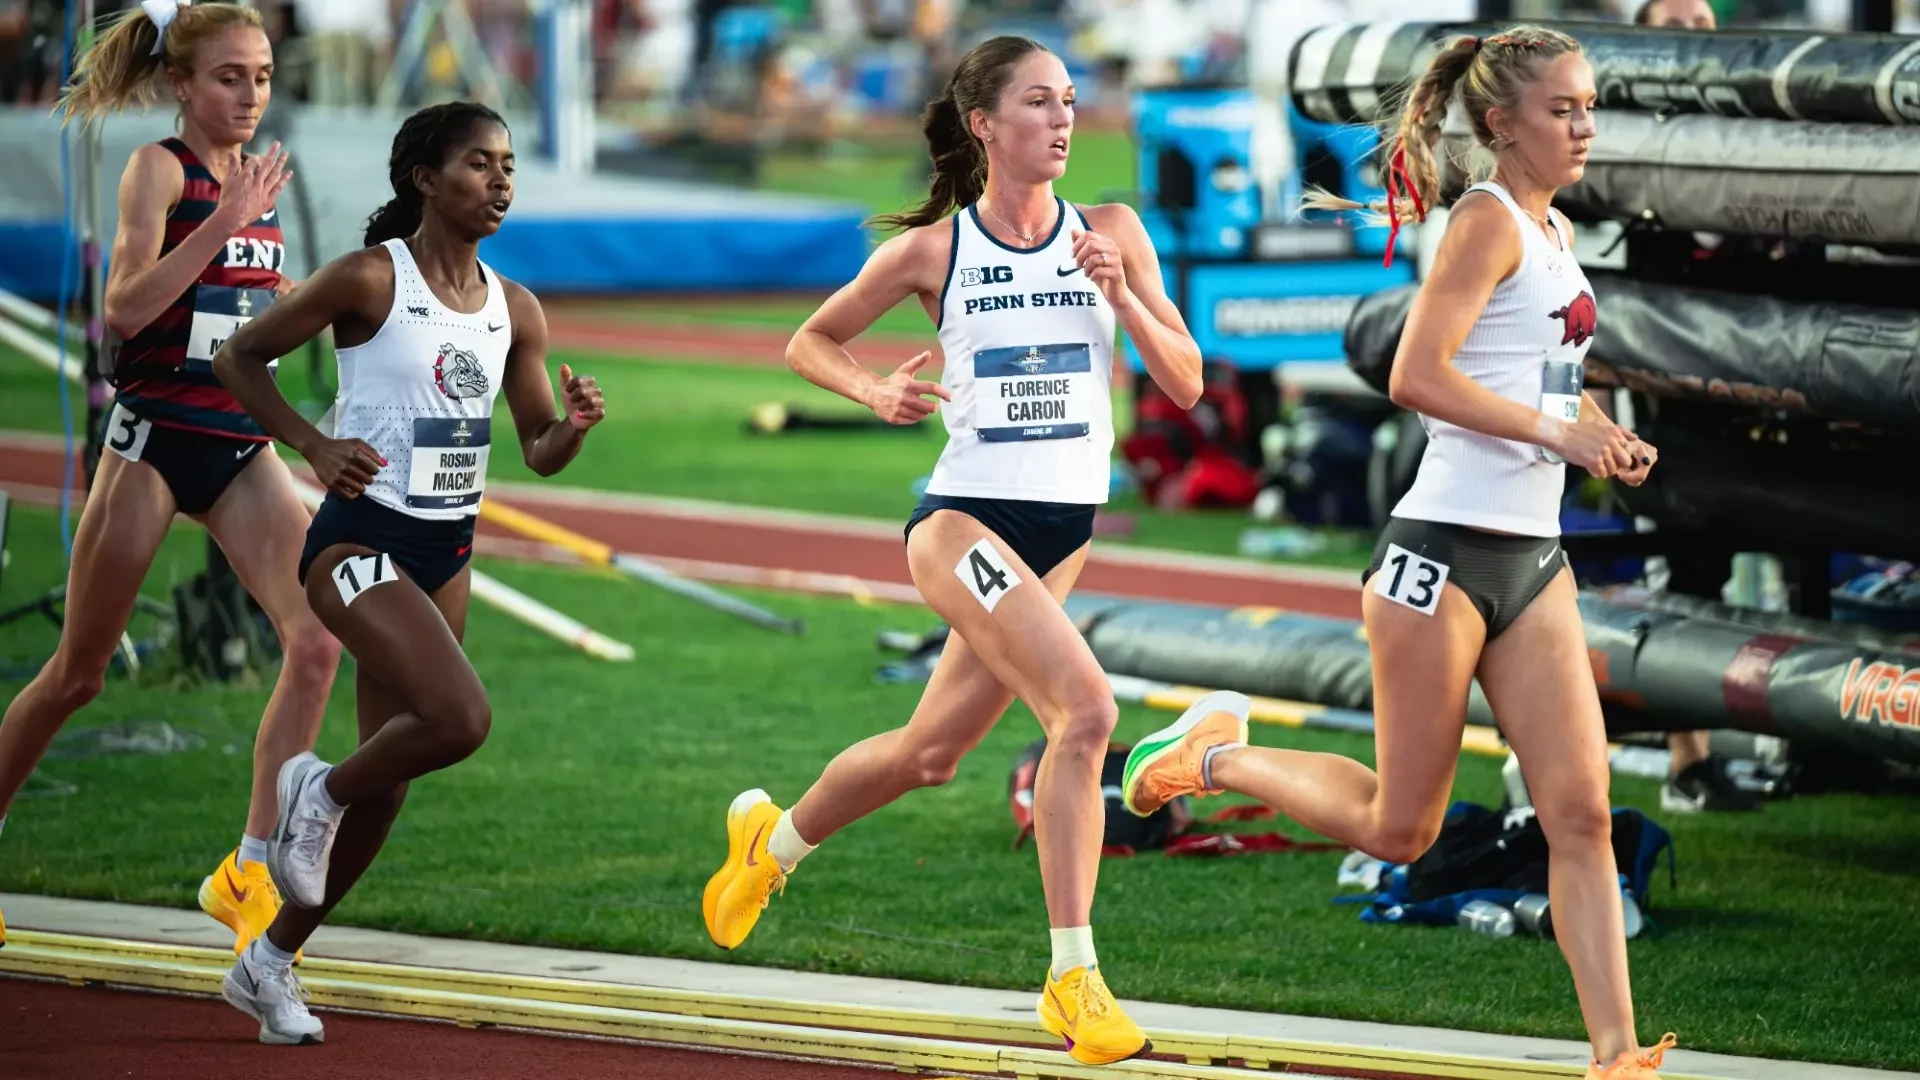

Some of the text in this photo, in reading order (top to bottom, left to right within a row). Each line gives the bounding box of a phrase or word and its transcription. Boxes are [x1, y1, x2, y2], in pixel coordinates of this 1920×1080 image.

[964, 290, 1097, 315] PENN STATE
[1001, 379, 1071, 398] FLORENCE
[1007, 400, 1066, 422] CARON
[440, 452, 477, 468] ROSINA
[432, 471, 477, 491] MACHU
[339, 553, 384, 594] 17
[969, 548, 1009, 597] 4
[1388, 553, 1440, 608] 13
[1840, 656, 1920, 731] VIRGI
